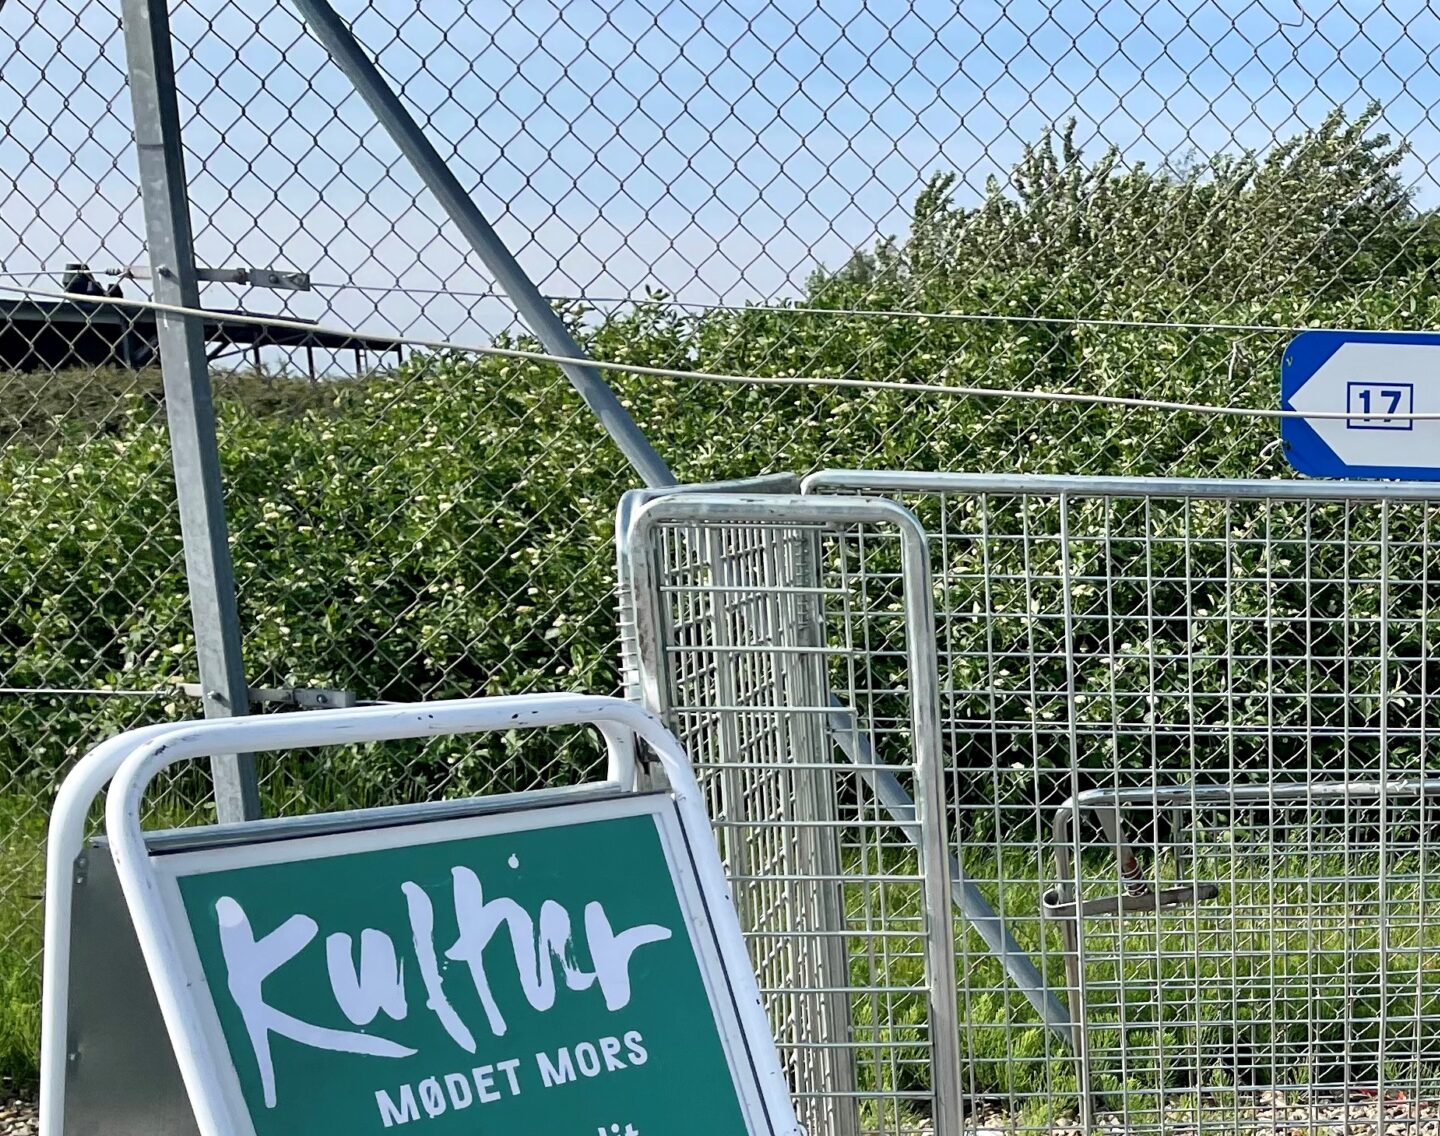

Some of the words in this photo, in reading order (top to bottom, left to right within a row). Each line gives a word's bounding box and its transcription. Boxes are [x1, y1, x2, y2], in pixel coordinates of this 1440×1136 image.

[1357, 389, 1402, 425] 17
[214, 853, 673, 1109] Kultur
[374, 1058, 521, 1128] MØDET
[535, 1030, 648, 1088] MORS
